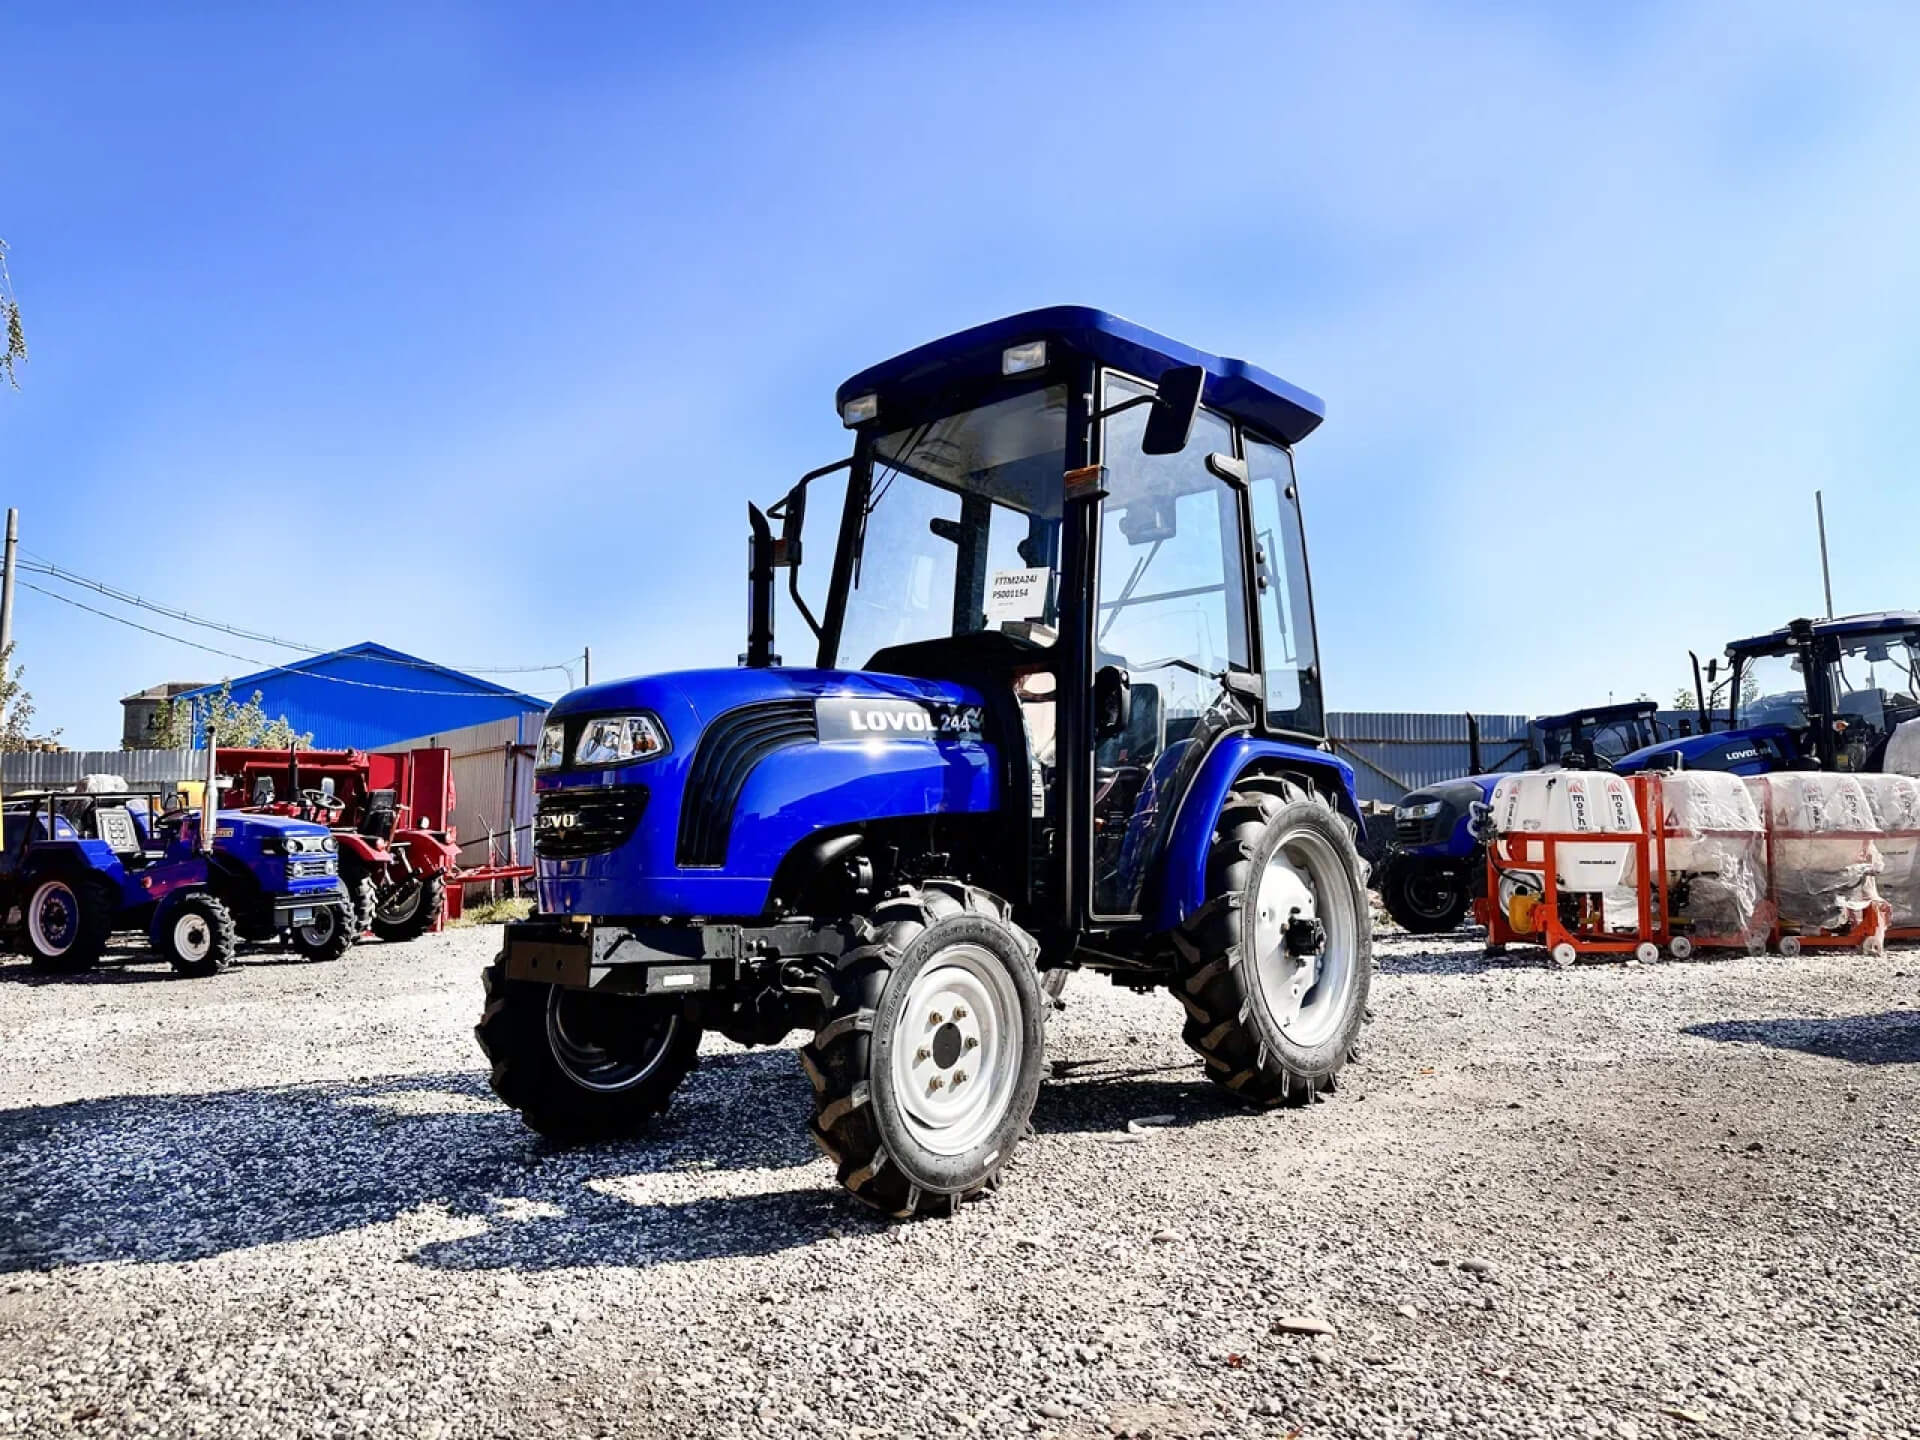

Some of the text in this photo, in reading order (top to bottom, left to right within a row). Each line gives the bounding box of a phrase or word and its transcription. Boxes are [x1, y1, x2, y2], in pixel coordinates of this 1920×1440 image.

[849, 710, 971, 732] LOVOL 244
[1572, 794, 1586, 826] mosh
[1611, 794, 1626, 825] mosh
